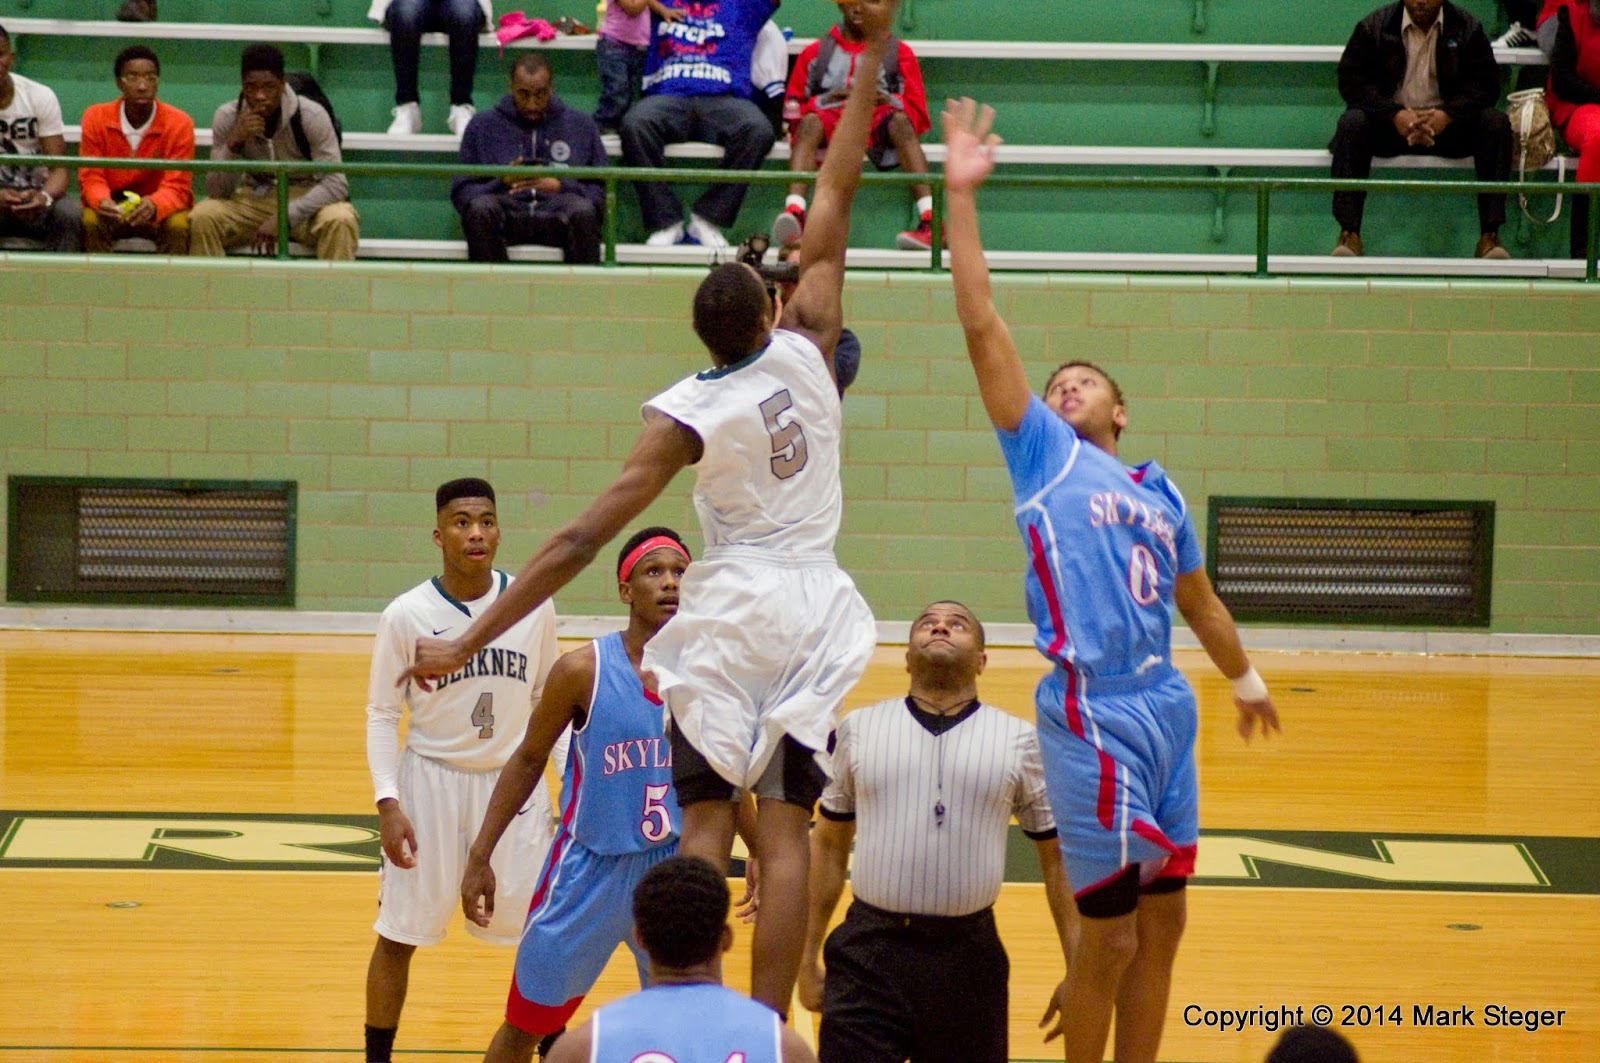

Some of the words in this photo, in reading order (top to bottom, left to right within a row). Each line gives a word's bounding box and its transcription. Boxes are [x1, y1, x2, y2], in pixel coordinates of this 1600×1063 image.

[757, 388, 808, 480] 5
[1127, 543, 1160, 607] 0
[470, 691, 495, 740] 4
[640, 783, 672, 843] 5
